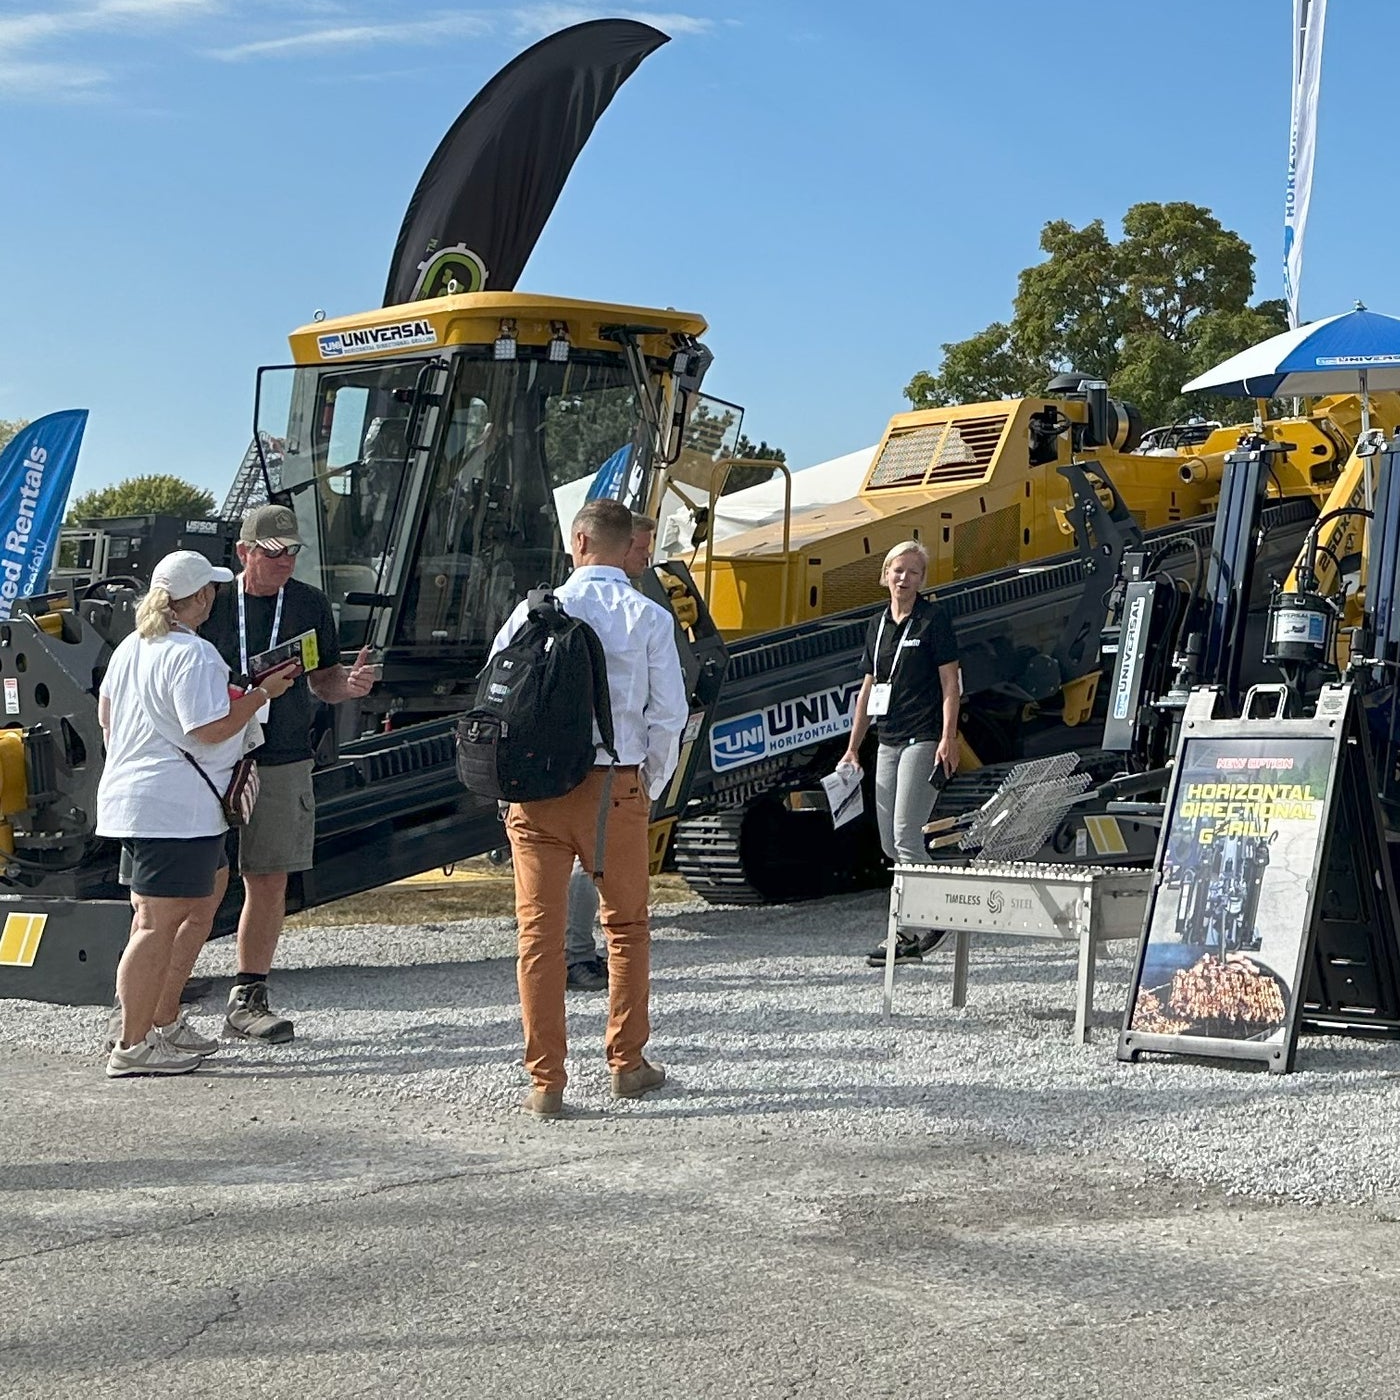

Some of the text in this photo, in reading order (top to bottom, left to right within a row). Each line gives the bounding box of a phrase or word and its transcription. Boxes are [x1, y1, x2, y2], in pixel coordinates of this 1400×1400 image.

[341, 321, 434, 347] UNIVERSAL
[0, 446, 47, 619] ited Rentals
[1120, 599, 1141, 692] UNIVERSAL
[713, 685, 863, 752] UNI UNIV
[770, 724, 840, 750] HORIZONTAL
[1187, 783, 1315, 801] HORIZONTAL
[1180, 802, 1317, 819] DIRECTIONAL
[945, 893, 981, 906] TIMELESS
